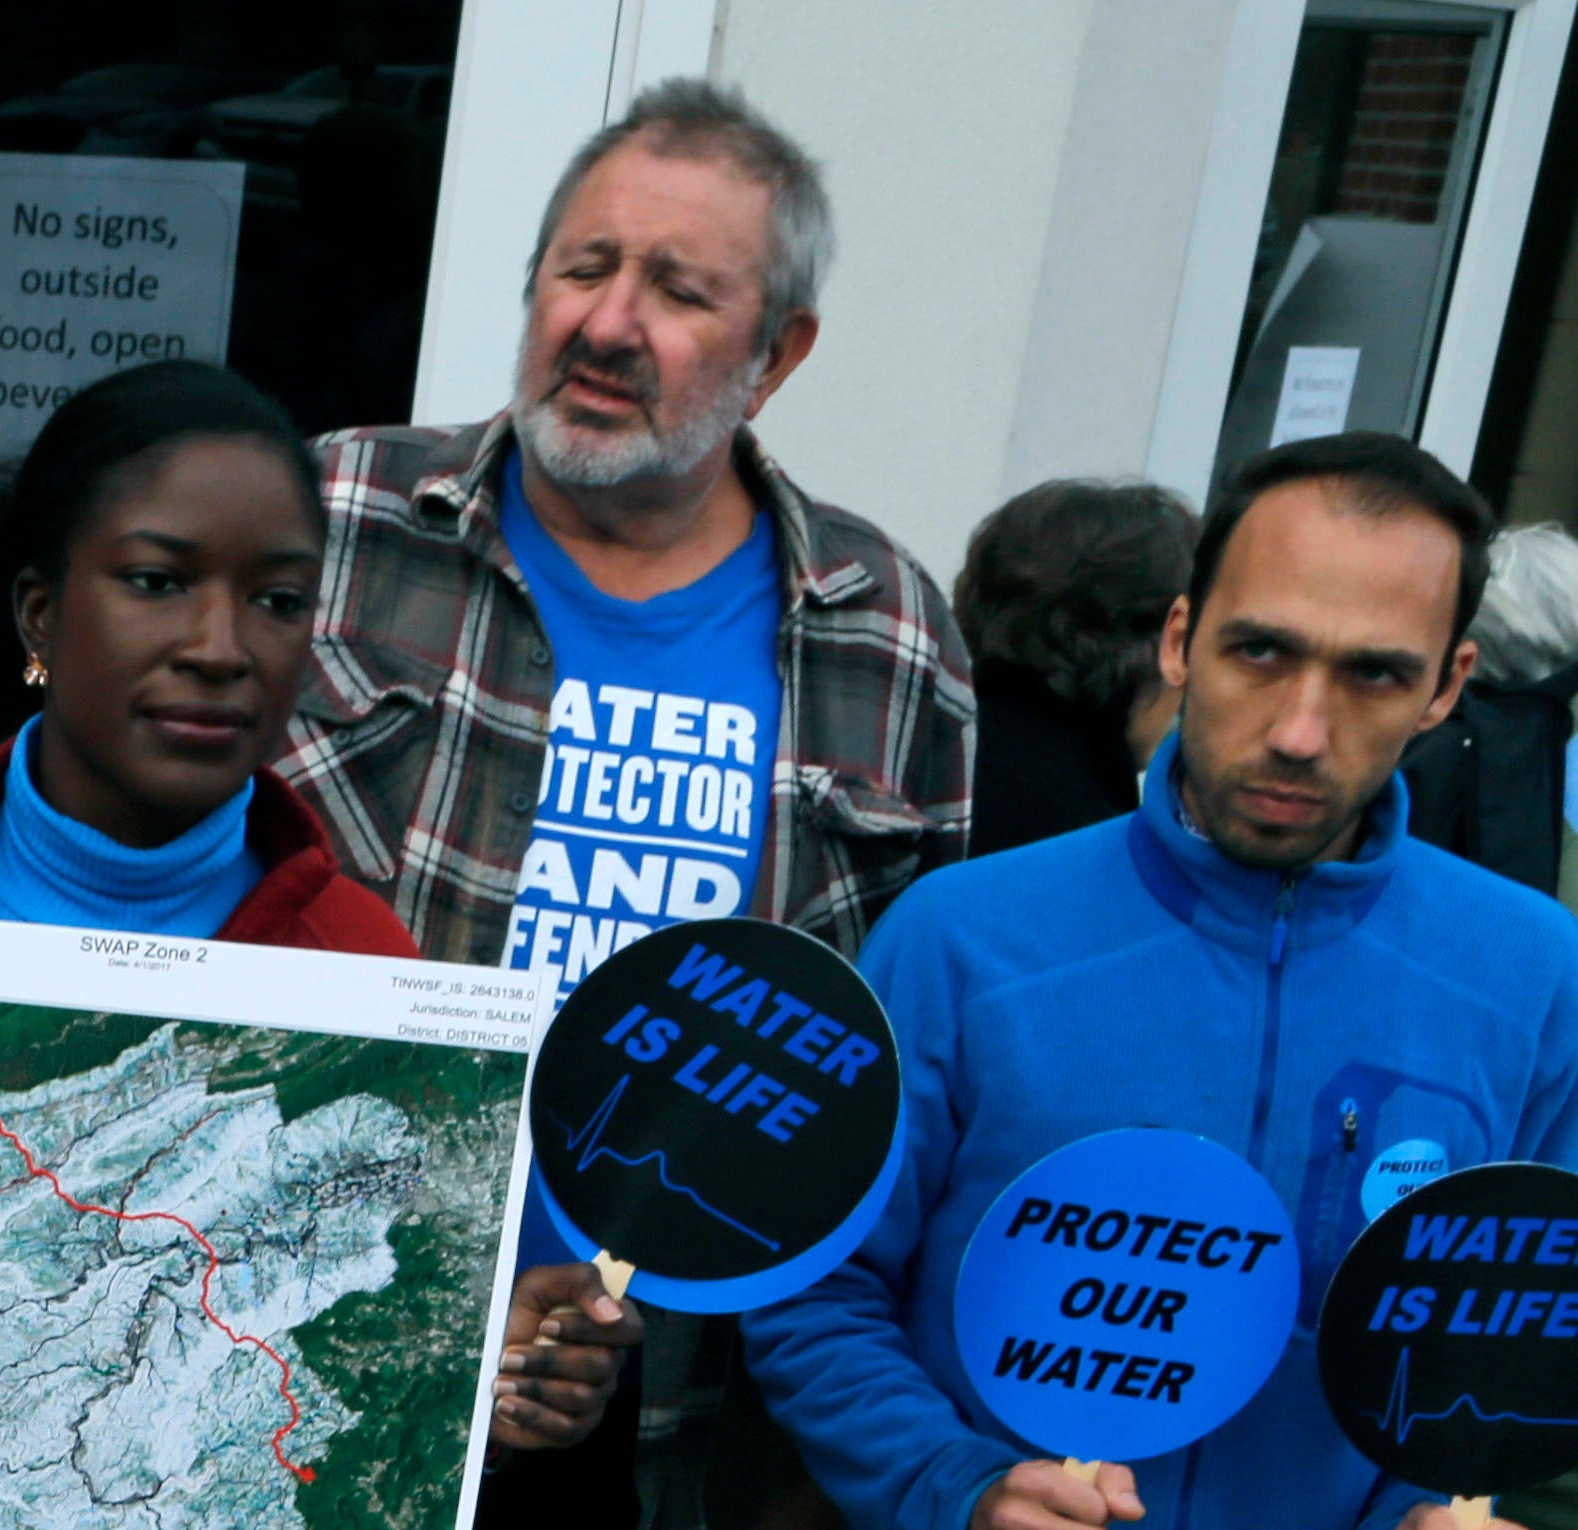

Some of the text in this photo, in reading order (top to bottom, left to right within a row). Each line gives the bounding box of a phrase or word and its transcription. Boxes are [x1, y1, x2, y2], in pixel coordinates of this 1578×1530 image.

[12, 203, 178, 250] No signs,
[20, 265, 159, 302] outside
[90, 329, 186, 364] open
[549, 678, 757, 766] ATER
[515, 838, 742, 920] AND
[80, 935, 208, 964] SWAP Zone 2
[446, 1028, 508, 1045] DISTRICT
[512, 1034, 528, 1047] 05
[485, 1009, 532, 1024] SALEM
[666, 942, 881, 1087] WATER
[602, 1004, 822, 1144] IS LIFE
[1378, 1158, 1445, 1175] PROTECT
[1005, 1196, 1282, 1274] PROTECT
[1403, 1214, 1578, 1266] WATE
[1058, 1277, 1189, 1334] OUR
[1366, 1285, 1578, 1338] IS LIFE
[992, 1336, 1196, 1405] WATER
